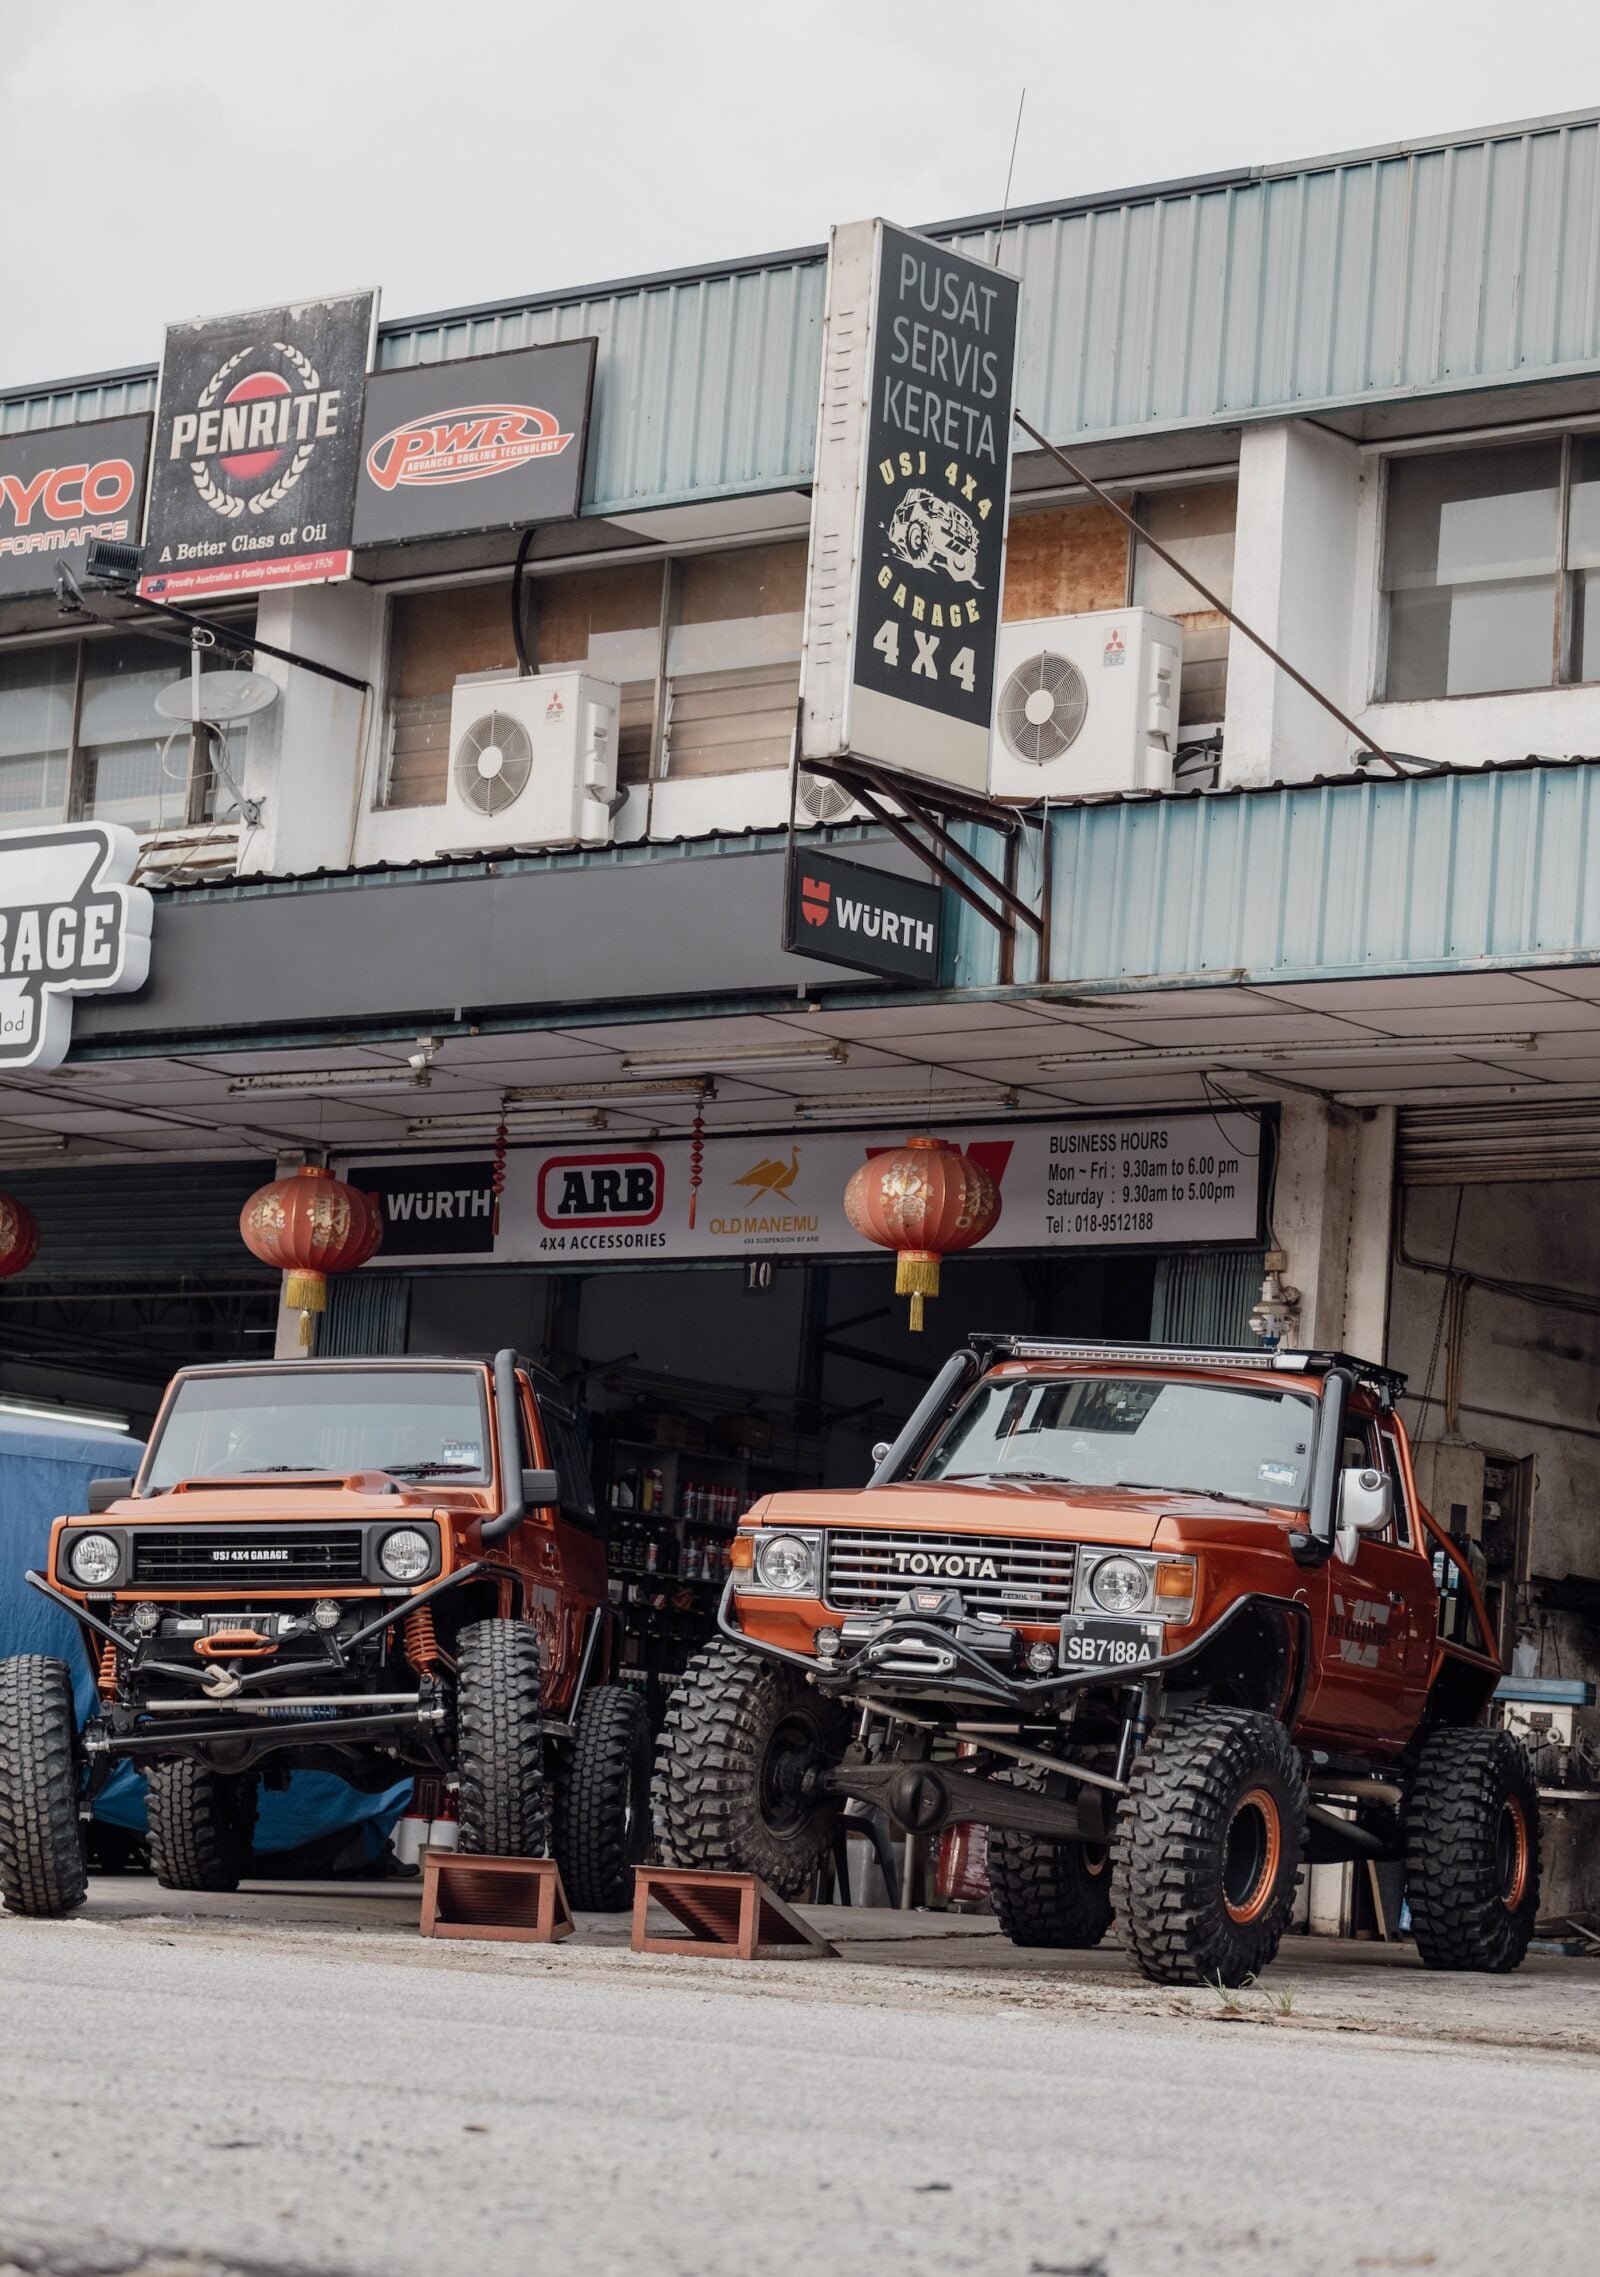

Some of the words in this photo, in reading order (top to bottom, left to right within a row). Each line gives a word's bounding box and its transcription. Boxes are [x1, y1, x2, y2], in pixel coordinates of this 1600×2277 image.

[900, 253, 997, 334] PUSAT
[891, 316, 997, 399] SERVIS
[170, 390, 340, 460] PENRITE
[883, 376, 995, 465] KERETA
[407, 457, 453, 472] ADVANCED
[457, 451, 497, 464] COOLING
[500, 440, 559, 457] TECHNOLOGY
[0, 460, 134, 526] YCO
[879, 451, 927, 485] USJ
[944, 462, 992, 520] 4X4
[159, 546, 172, 563] A
[176, 541, 227, 561] Better
[231, 535, 275, 553] Class
[280, 527, 298, 546] of
[302, 523, 327, 543] Oil
[167, 576, 195, 588] Proudly
[196, 572, 232, 584] Australian
[234, 571, 241, 580] &
[241, 567, 265, 580] Family
[266, 564, 291, 576] Owned
[291, 559, 313, 574] Since
[314, 556, 335, 569] 1926
[878, 565, 980, 627] GARAGE
[873, 620, 975, 692] 4X4
[0, 904, 114, 973] AGE
[836, 897, 933, 953] WÜRTH
[1050, 1133, 1117, 1154] BUSINESS
[1120, 1131, 1168, 1151] HOURS
[1049, 1164, 1075, 1181] Mon
[1091, 1161, 1107, 1179] Fri
[1123, 1159, 1167, 1178] 9.30am
[1172, 1159, 1184, 1176] to
[1188, 1156, 1214, 1175] 6.00
[1218, 1158, 1239, 1178] pm
[387, 1189, 491, 1221] WÜRTH
[557, 1168, 654, 1214] ARB
[1047, 1187, 1104, 1208] Saturday
[1123, 1184, 1167, 1203] 9.30am
[1172, 1183, 1184, 1201] to
[1188, 1181, 1235, 1203] 5.00pm
[709, 1218, 741, 1235] OLD
[1046, 1216, 1064, 1233] Tel
[1075, 1212, 1153, 1232] 018-9512188
[540, 1237, 566, 1251] 4X4
[570, 1233, 666, 1249] ACCESSORIES
[756, 1236, 795, 1244] SUSPENSION
[748, 1261, 772, 1288] 10
[213, 1551, 230, 1560] USJ
[231, 1551, 249, 1560] 4X4
[251, 1550, 288, 1560] GARAGE
[895, 1553, 998, 1578] TOYOTA
[1068, 1637, 1151, 1664] SB7188A
